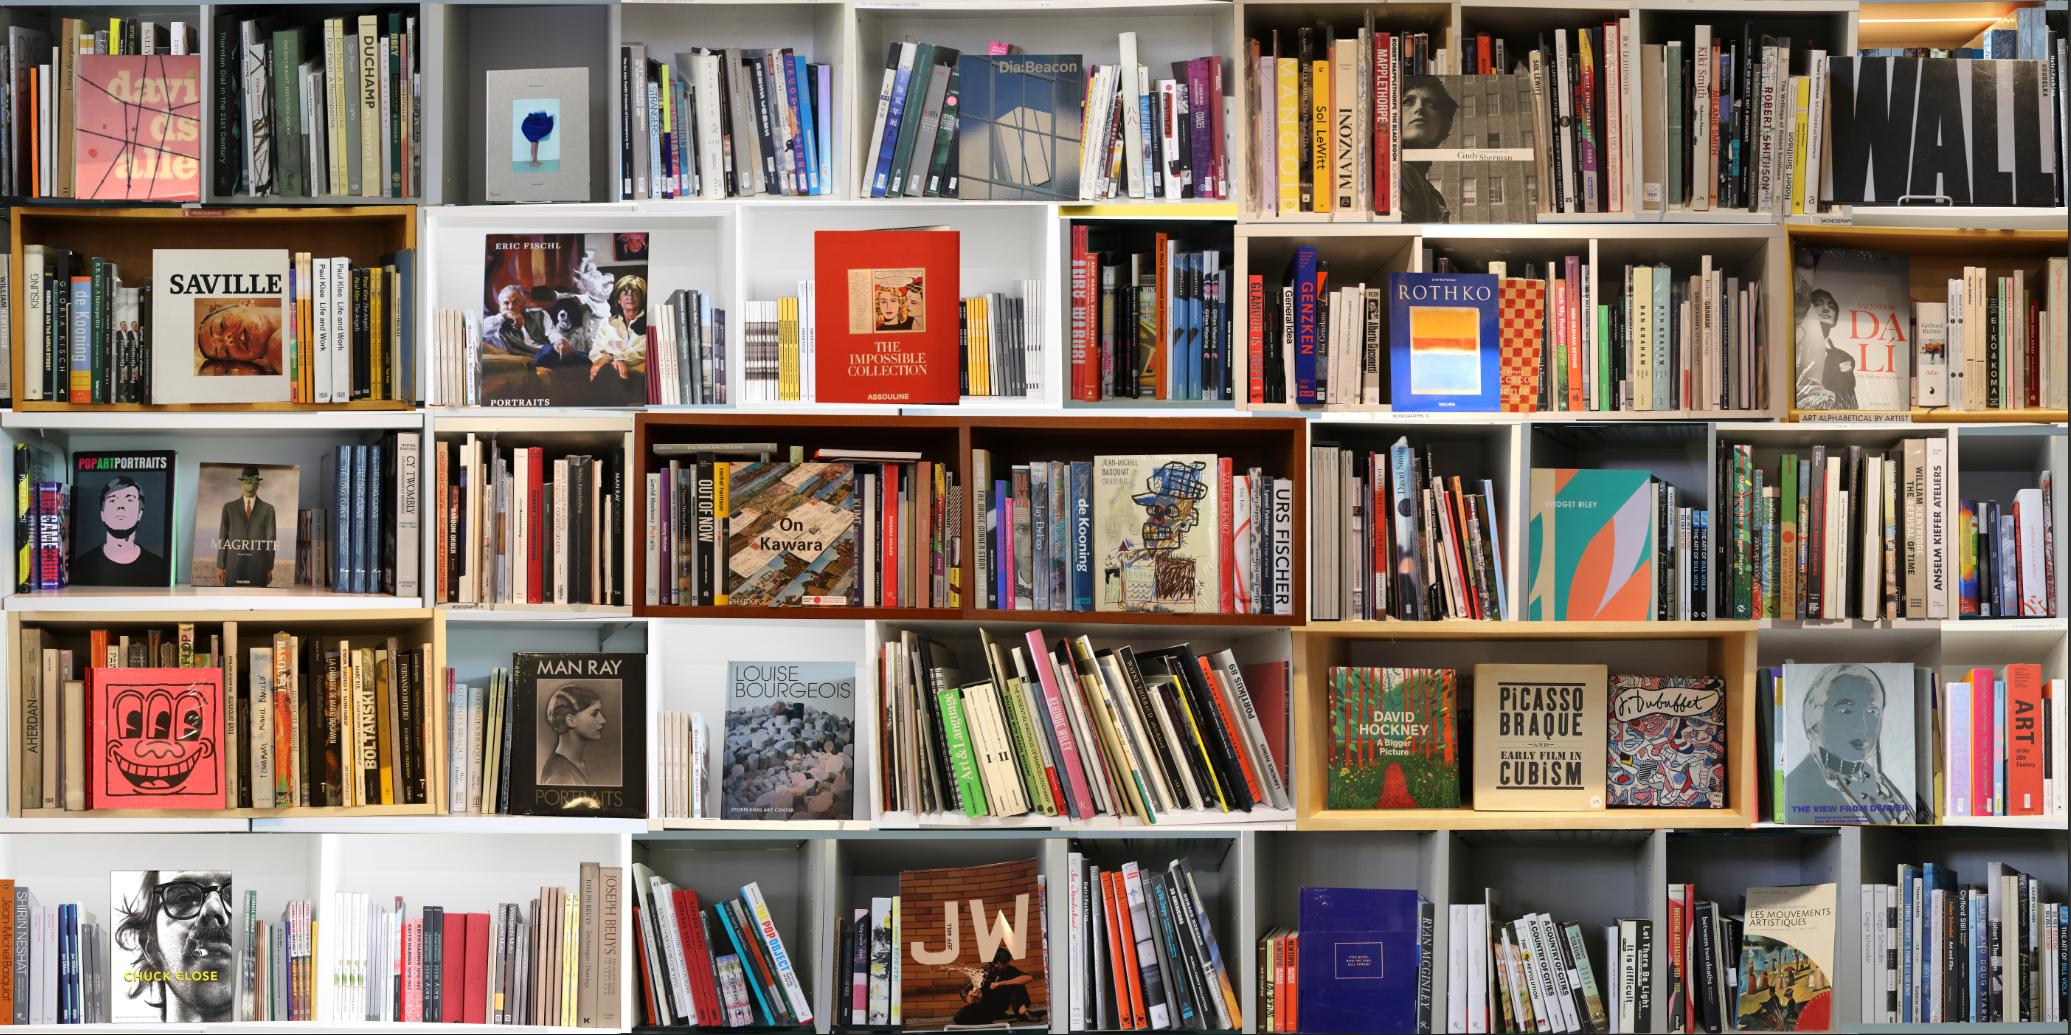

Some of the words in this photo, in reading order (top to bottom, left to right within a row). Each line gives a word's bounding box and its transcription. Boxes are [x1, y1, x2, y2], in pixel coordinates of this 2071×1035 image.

[999, 61, 1077, 74] Dia:Beacon
[1697, 47, 1707, 66] Kiki
[363, 35, 375, 110] DUCHAMP
[1697, 69, 1707, 99] Smith
[107, 69, 199, 104] davi
[1377, 49, 1388, 123] MAPPLETHORPE
[650, 86, 658, 137] STRANGERS
[1317, 106, 1327, 124] Sol
[1764, 86, 1773, 129] ROBERT
[150, 111, 198, 141] ds
[1391, 125, 1399, 143] BLACK
[1828, 56, 2056, 204] WALL
[1316, 129, 1327, 171] LeWitt
[1339, 108, 1353, 190] MANZONI
[1457, 151, 1478, 160] Cindy
[1785, 131, 1795, 170] Smithson
[114, 147, 198, 181] alle
[1762, 135, 1771, 191] SMITHSON
[1784, 172, 1793, 201] Robert
[495, 242, 520, 251] ERIC
[523, 241, 562, 251] FISCHL
[30, 273, 40, 310] KISLING
[169, 273, 283, 295] SAVILLE
[319, 281, 327, 298] Klee
[1398, 284, 1491, 301] ROTHKO
[59, 280, 67, 328] GLORIA
[75, 290, 89, 306] de
[319, 302, 327, 315] Life
[1285, 290, 1294, 325] General
[319, 316, 327, 331] and
[1301, 281, 1314, 355] GENZKEN
[1849, 309, 1907, 342] DA
[71, 311, 90, 363] Kooning
[319, 332, 327, 352] Work
[1286, 325, 1294, 345] Idea
[1368, 321, 1379, 343] Alberto
[1990, 317, 1998, 350] EIKO
[873, 341, 901, 353] THE
[1367, 343, 1379, 374] Giacometti
[847, 364, 928, 377] COLLECTION
[849, 353, 926, 365] IMPOSSIBLE
[1990, 360, 1998, 395] KOMA
[490, 398, 550, 407] PORTRAITS
[867, 392, 909, 401] ASSOULINE
[1802, 414, 1817, 422] ART
[1818, 414, 1873, 422] ALPHABETICAL
[1874, 414, 1883, 422] BY
[1884, 414, 1910, 422] ARTIST
[406, 455, 416, 469] CY
[1101, 459, 1139, 467] JEAN-MICHEL
[1101, 468, 1129, 477] BASQUIAT
[405, 471, 416, 515] TWOMBLY
[698, 479, 714, 500] OUT
[977, 490, 986, 502] THE
[1906, 481, 1915, 498] THE
[1915, 466, 1924, 505] WILLIAM
[1933, 465, 1942, 508] ATELIERS
[698, 502, 714, 515] OF
[977, 503, 986, 524] BRUCE
[1078, 498, 1090, 515] de
[1275, 488, 1291, 523] URS
[1577, 500, 1598, 509] RILEY
[698, 517, 713, 543] NOW
[779, 517, 804, 532] On
[1907, 499, 1916, 539] REFUSAL
[1933, 511, 1942, 545] KIEFER
[977, 525, 986, 550] CONNER
[1916, 506, 1924, 556] KENTRIDGE
[210, 539, 281, 551] MAGRITTE
[760, 536, 823, 551] Kawara
[1076, 517, 1090, 573] Kooning
[1907, 541, 1916, 552] OF
[978, 551, 986, 570] STORY
[1275, 529, 1291, 605] FISCHER
[1908, 554, 1916, 576] TIME
[1933, 548, 1943, 592] ANSELM
[537, 659, 582, 675] MAN
[588, 659, 623, 675] RAY
[736, 665, 799, 682] LOUISE
[735, 682, 851, 698] BOURGEOIS
[1127, 659, 1140, 684] WAYNE
[1136, 685, 1154, 719] THIEBAUD
[1628, 690, 1704, 713] Dubuffet
[27, 698, 39, 755] AHERDAN
[943, 693, 966, 750] Language
[1374, 711, 1415, 723] DAVID
[1499, 712, 1583, 741] BRAQUE
[2015, 699, 2035, 745] ART
[362, 689, 377, 769] BOLTANSKI
[1359, 723, 1429, 736] HOCKNEY
[955, 749, 968, 760] &
[1260, 743, 1271, 764] WEINER
[1376, 739, 1383, 747] A
[1384, 738, 1412, 748] Bigger
[1379, 748, 1409, 756] Picture
[1500, 751, 1536, 760] EARLY
[1539, 751, 1566, 760] FILM
[1570, 751, 1582, 760] IN
[958, 760, 974, 781] Art
[1265, 763, 1281, 790] LAWRENCE
[1791, 805, 1810, 814] THE
[1811, 805, 1838, 814] VIEW
[1839, 805, 1869, 813] FROM
[604, 874, 617, 915] JOSEPH
[1959, 889, 1967, 916] Clyfford
[16, 891, 28, 929] SHIRIN
[1183, 892, 1195, 918] HOWARD
[1190, 918, 1204, 947] HODGKIN
[1750, 910, 1764, 919] LES
[1766, 907, 1831, 919] MOUVEMENTS
[761, 920, 776, 939] POP
[910, 893, 1029, 965] JW
[1422, 916, 1432, 947] RYAN
[1641, 925, 1650, 940] Let
[1749, 917, 1807, 927] ARTISTIQUES
[604, 917, 618, 957] BEUYS
[1531, 925, 1548, 962] COUNTRY
[16, 931, 28, 976] NESHAT
[768, 937, 791, 973] OBJECT
[1642, 944, 1650, 967] There
[1701, 916, 1709, 947] between
[1705, 961, 1714, 985] deaths
[123, 970, 171, 983] CHUCK
[174, 970, 219, 982] CLOSE
[1539, 961, 1549, 972] OF
[1642, 971, 1650, 982] Be
[1419, 948, 1432, 1010] MCGINLEY
[1543, 971, 1555, 997] CITIES
[1640, 985, 1650, 1008] Light
